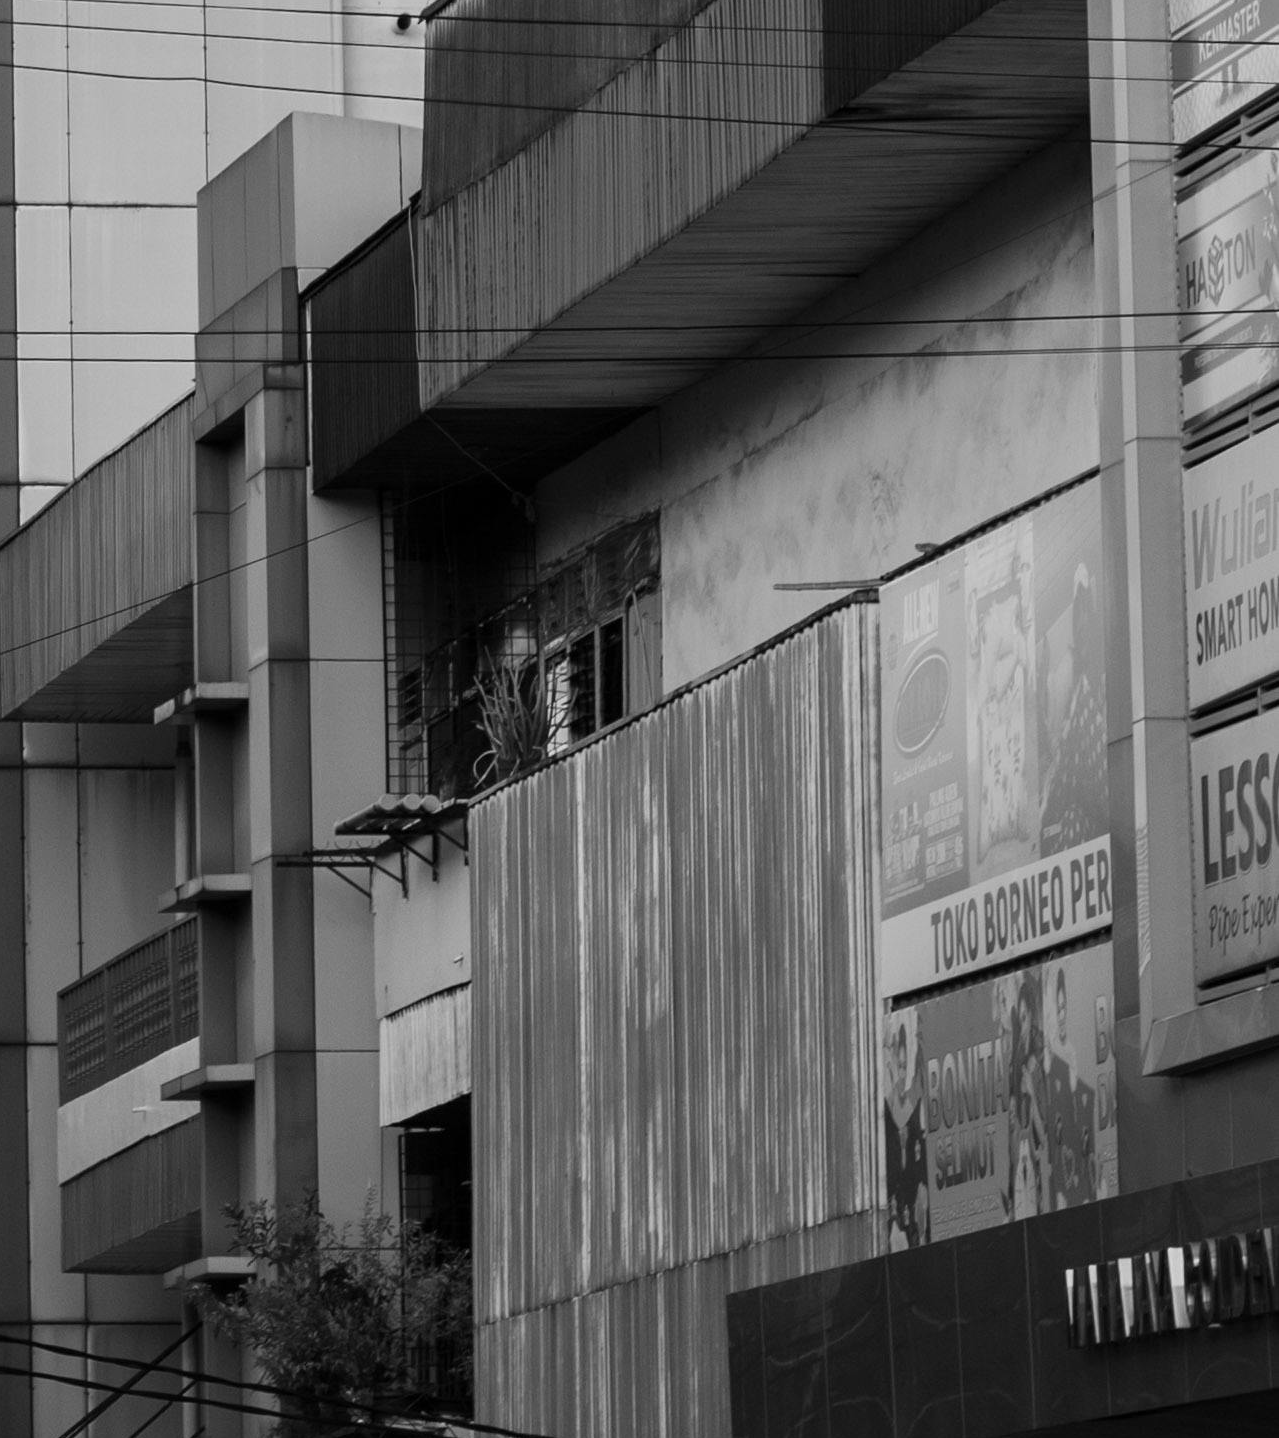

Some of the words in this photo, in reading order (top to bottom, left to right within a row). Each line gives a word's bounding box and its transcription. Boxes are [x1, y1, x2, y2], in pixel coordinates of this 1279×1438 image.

[1199, 0, 1261, 64] KENMASTER
[1196, 594, 1244, 666] SMART
[931, 898, 978, 973] TOKO
[984, 865, 1064, 955] BORNEO
[1070, 849, 1113, 925] PER
[1209, 904, 1240, 956] Pipe
[927, 1037, 1009, 1134] BONITA
